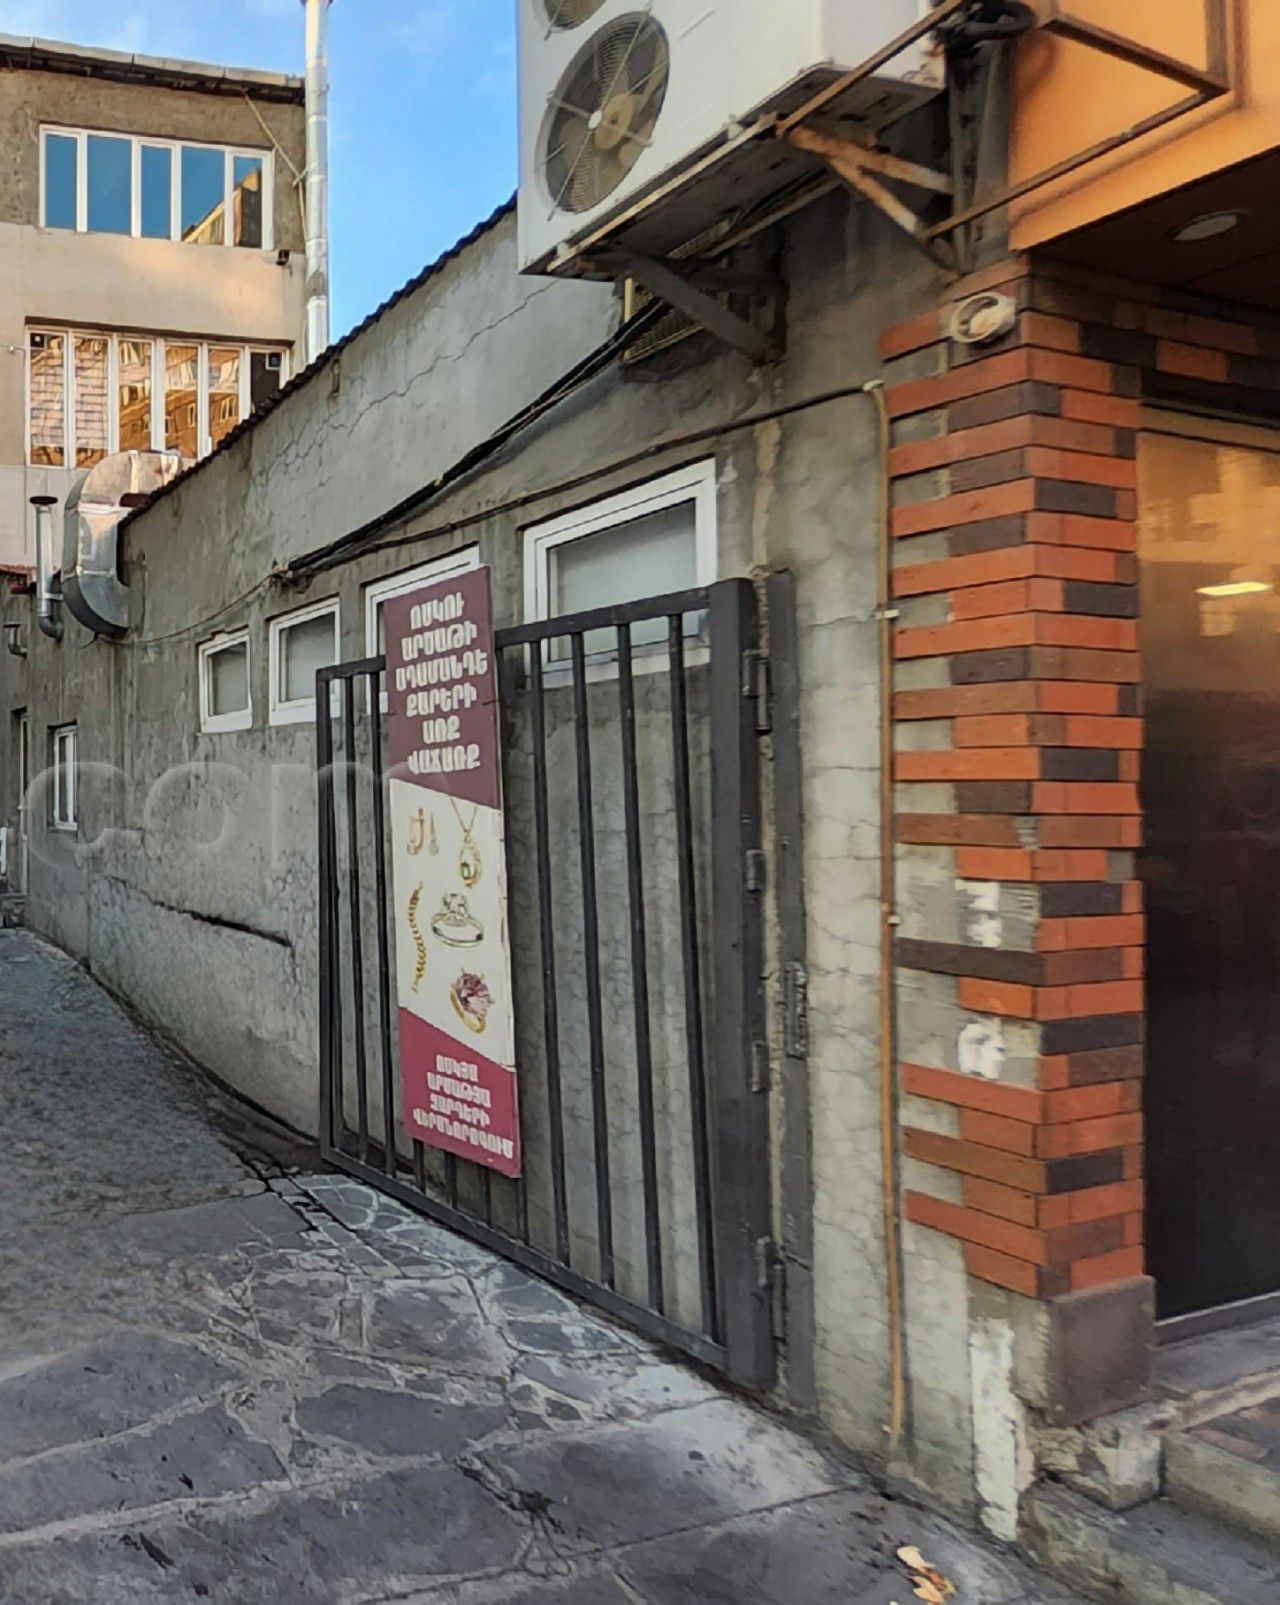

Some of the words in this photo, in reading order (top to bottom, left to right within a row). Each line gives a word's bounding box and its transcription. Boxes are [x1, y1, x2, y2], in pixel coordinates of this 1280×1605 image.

[410, 592, 465, 630] ՈՍԿՈՒ
[401, 620, 478, 661] ԱՐԾԱԹԻ
[395, 648, 488, 691] ԱԴԱՄԱՆԴԵ
[406, 682, 477, 717] ՔԱՐԵՐԻ
[422, 715, 460, 744] ԱՌՔ
[407, 743, 481, 775] ՎԱՃԱՌՔ
